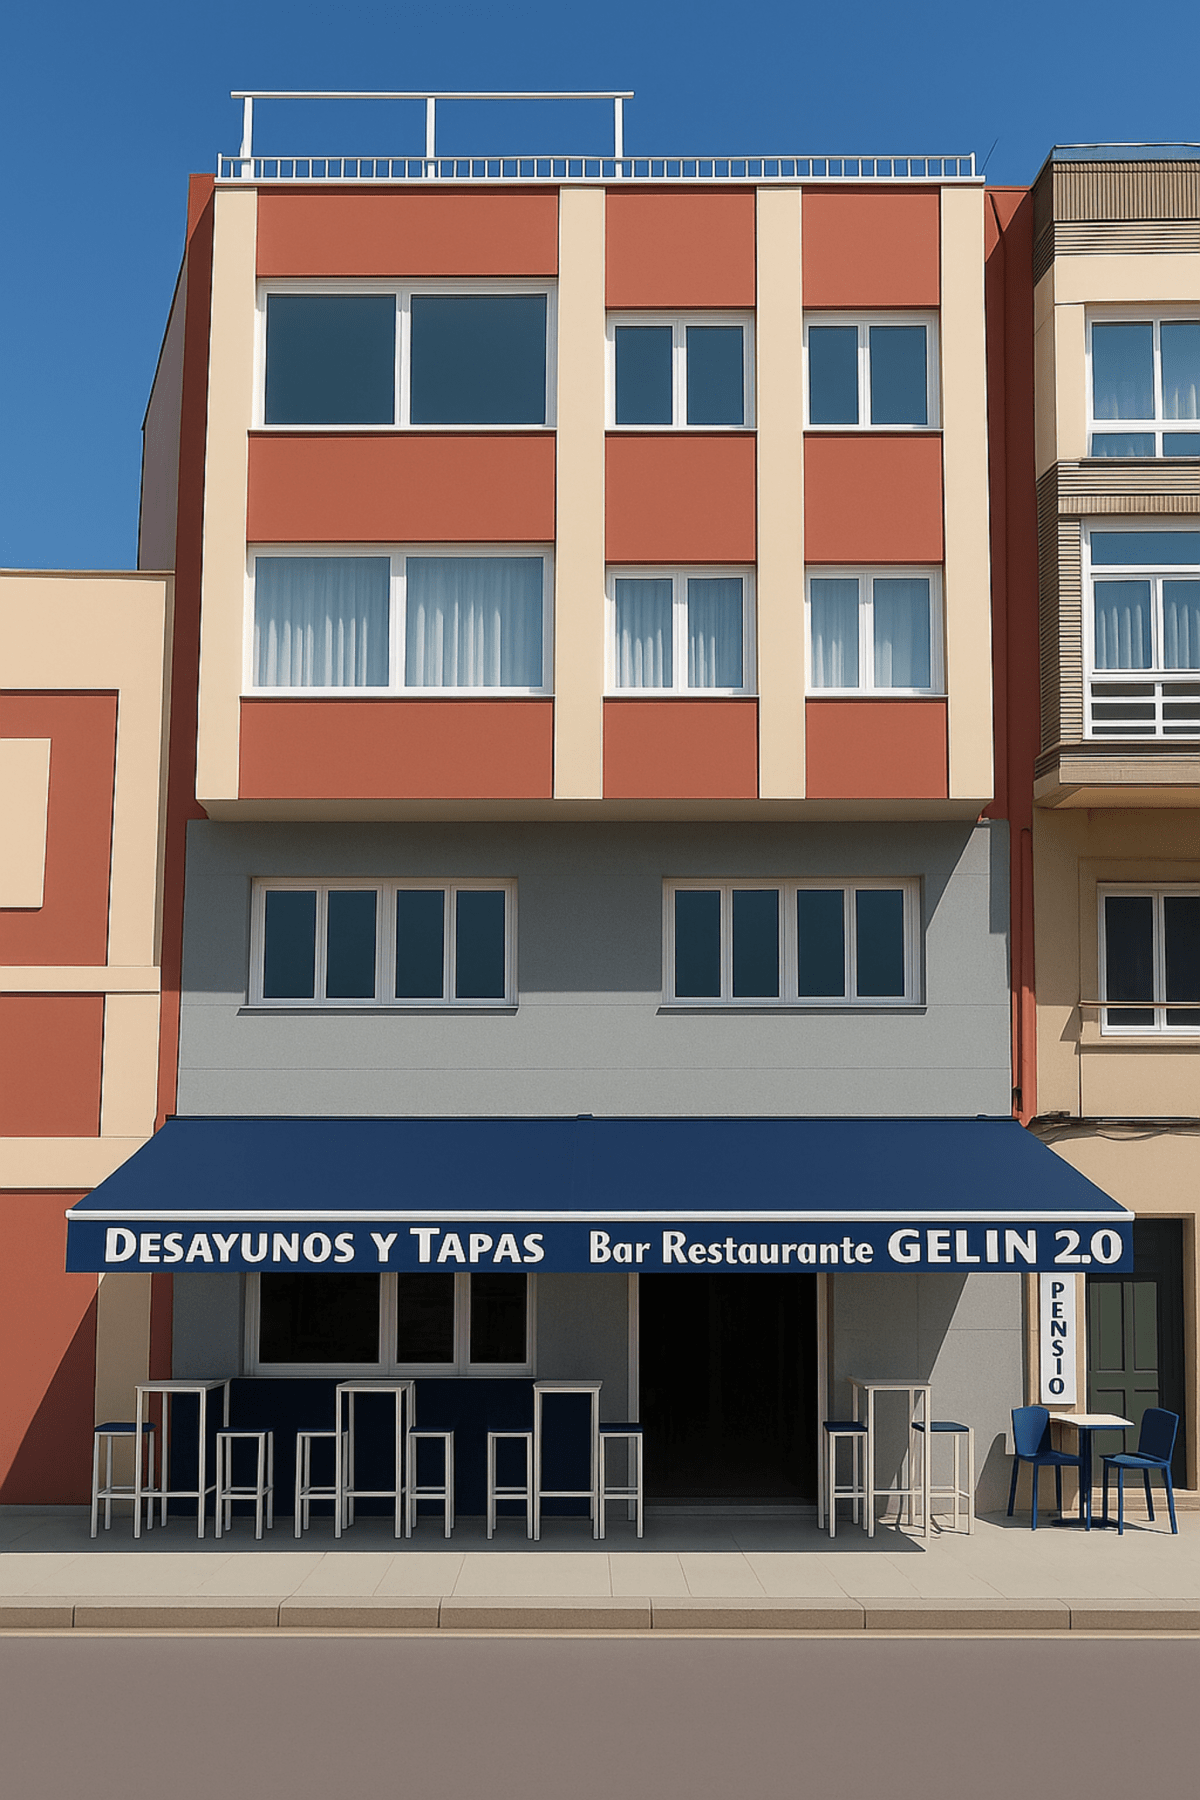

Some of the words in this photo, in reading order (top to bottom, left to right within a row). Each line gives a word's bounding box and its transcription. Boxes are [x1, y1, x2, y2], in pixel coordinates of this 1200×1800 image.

[105, 1227, 355, 1263] DESAYUNOS
[370, 1232, 398, 1263] Y
[409, 1227, 545, 1263] TAPAS
[588, 1230, 651, 1264] Bar
[662, 1230, 874, 1264] Restaurante
[887, 1228, 1037, 1264] GELIN
[1054, 1229, 1123, 1264] 2.0
[1048, 1281, 1067, 1395] PENSIO
